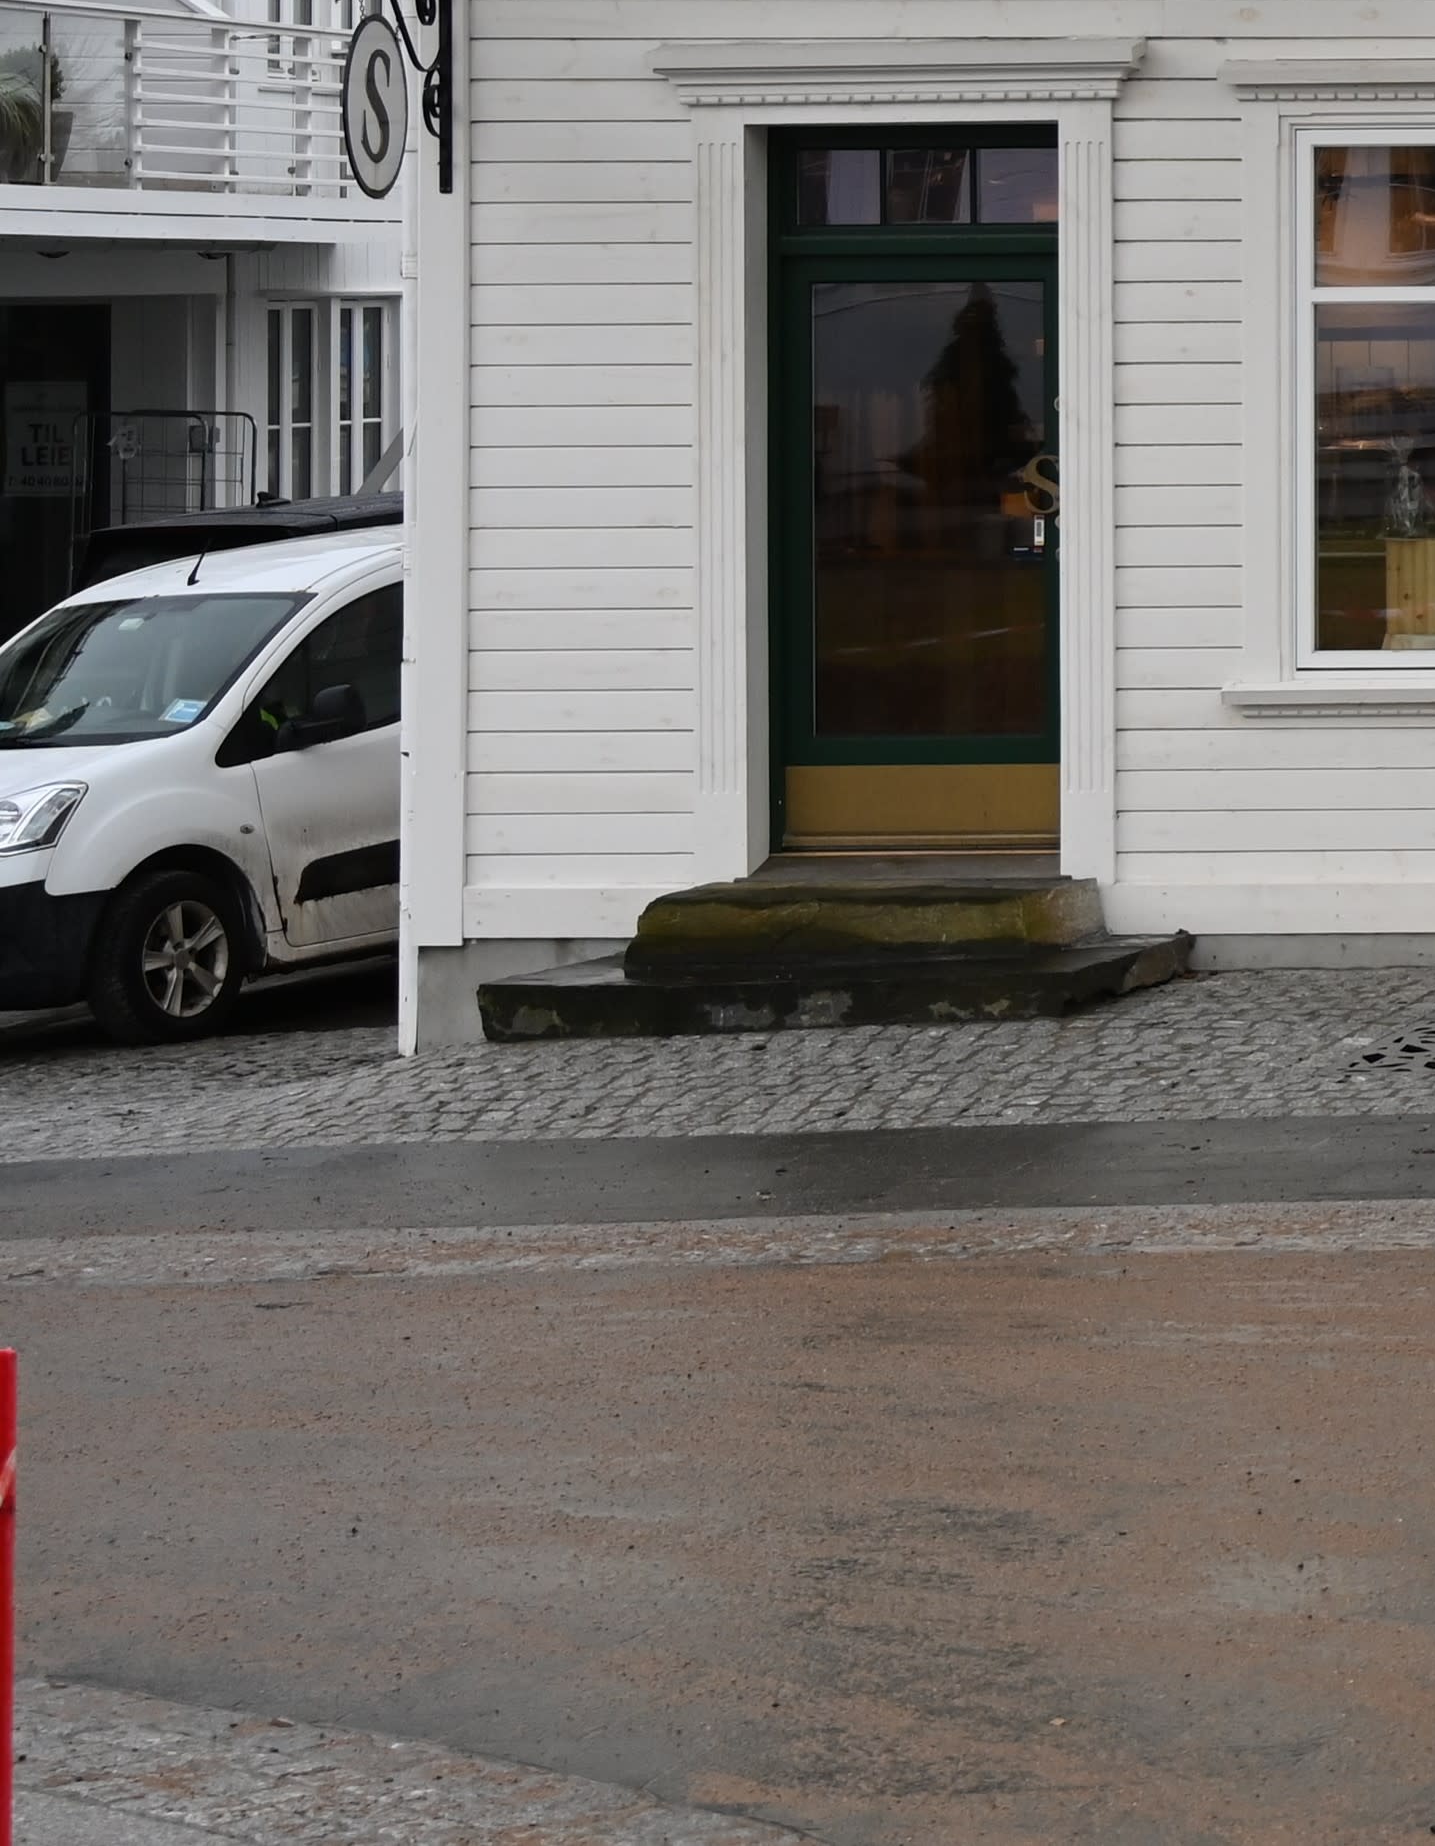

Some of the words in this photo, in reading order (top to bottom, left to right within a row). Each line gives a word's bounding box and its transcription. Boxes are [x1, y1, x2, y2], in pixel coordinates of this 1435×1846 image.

[360, 49, 391, 164] S
[28, 423, 65, 443] TIL
[21, 446, 71, 467] LEIE
